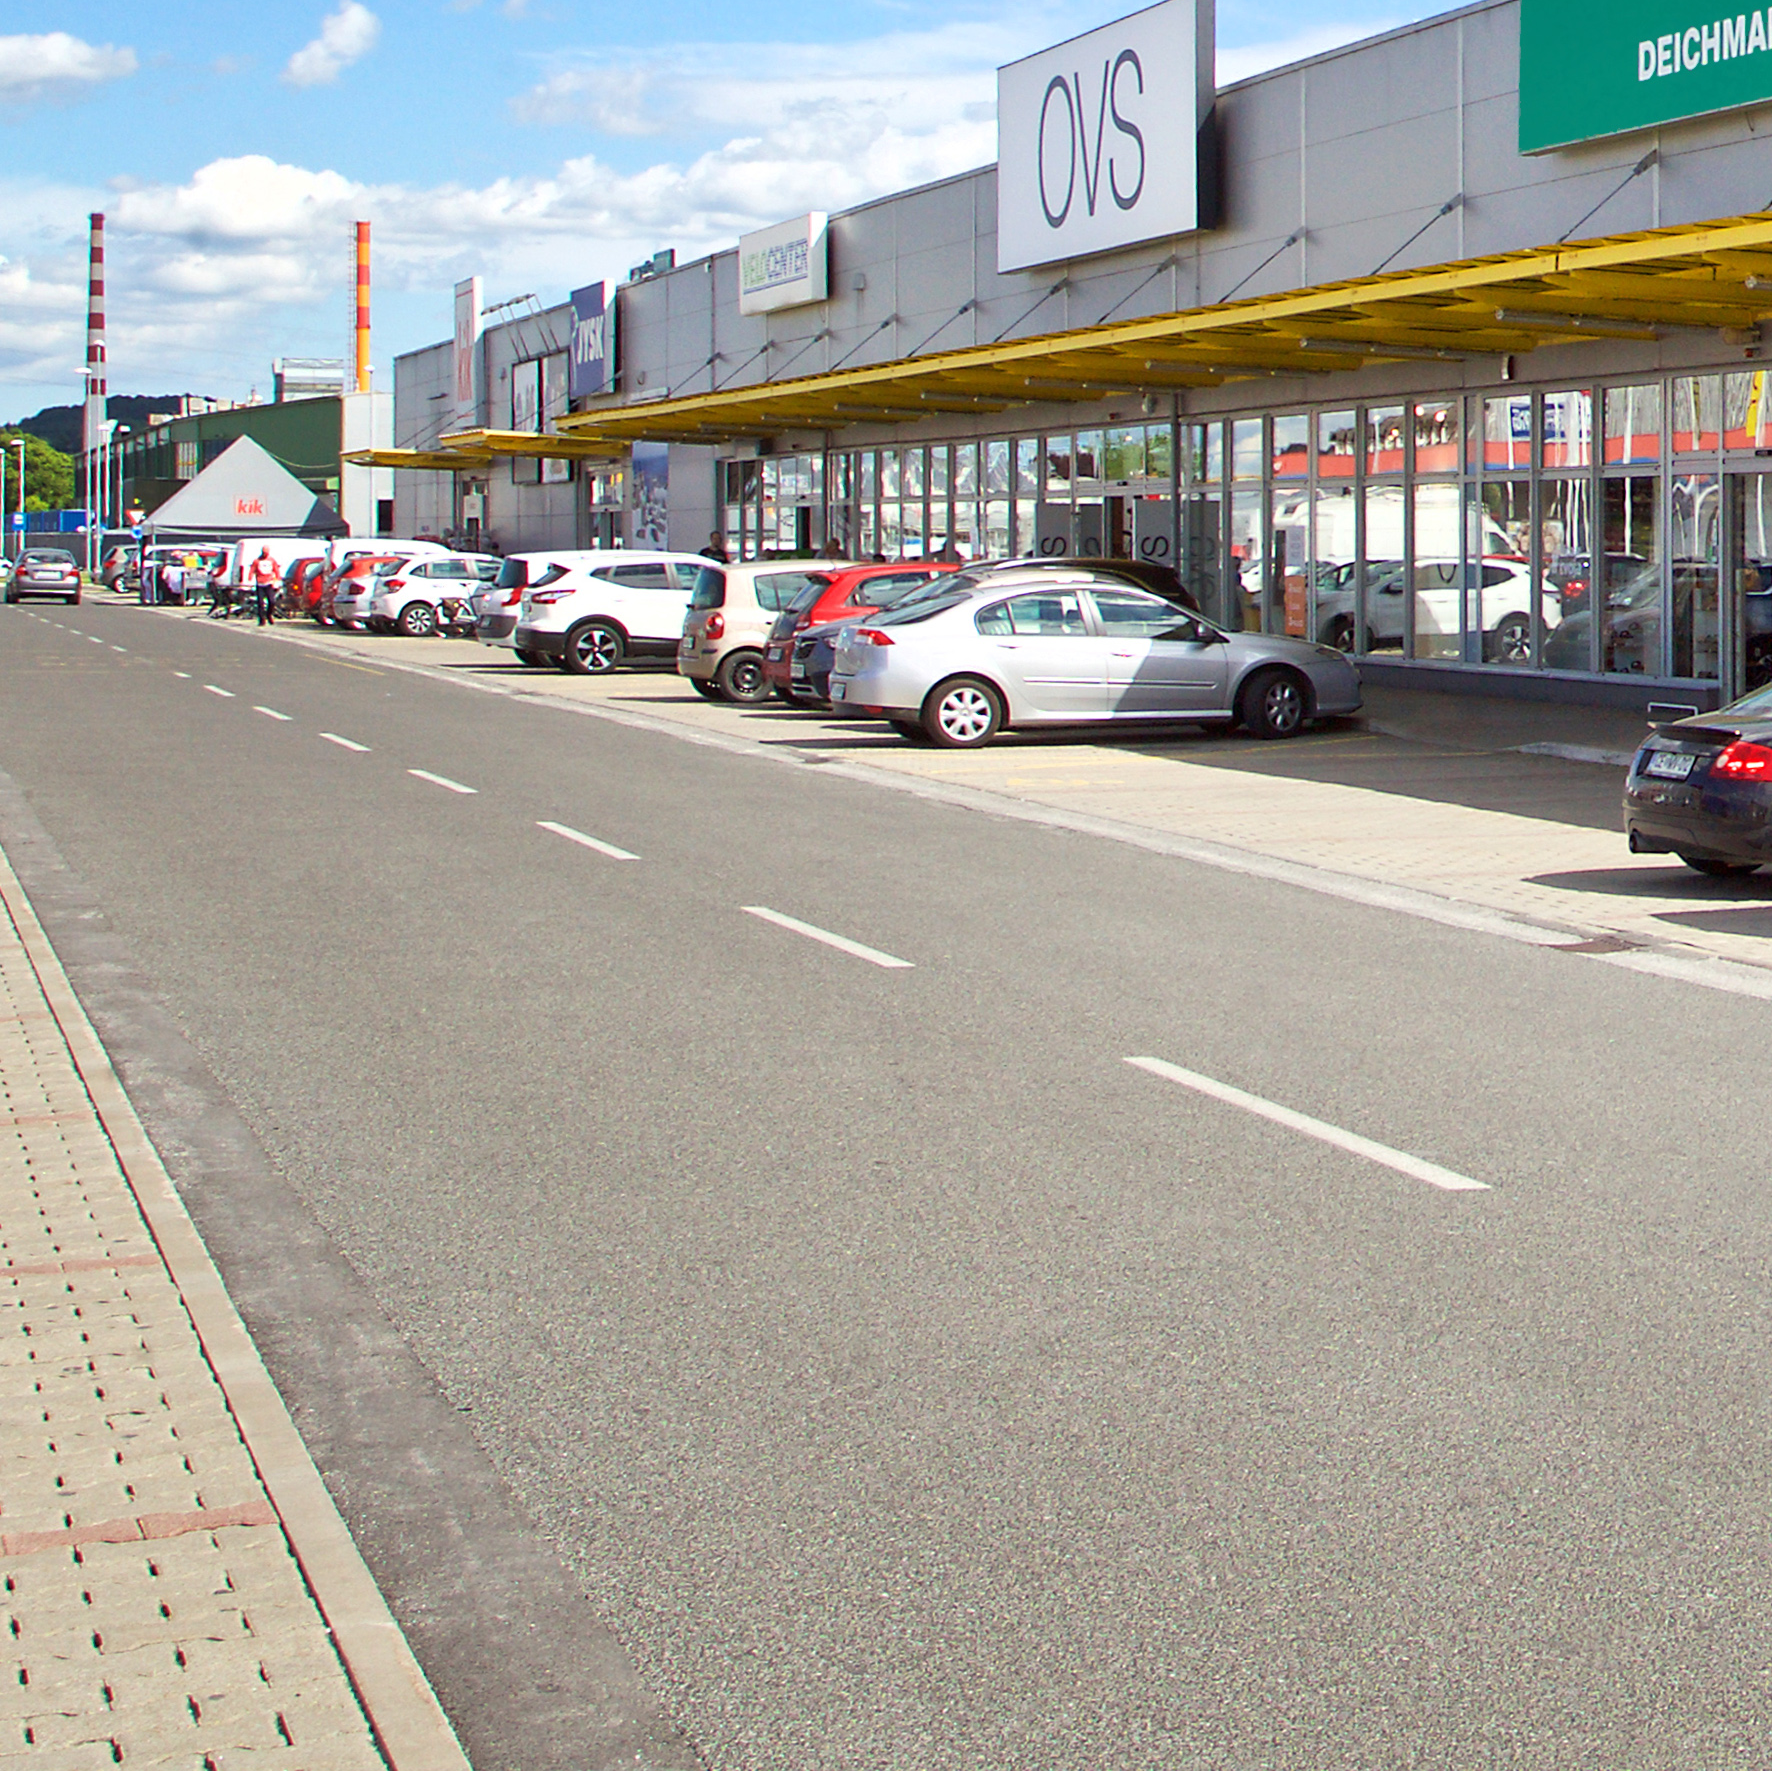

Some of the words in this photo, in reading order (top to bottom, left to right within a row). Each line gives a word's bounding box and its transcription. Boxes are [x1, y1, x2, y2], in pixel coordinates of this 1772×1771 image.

[1039, 49, 1145, 228] OVS
[576, 315, 604, 365] JYSK
[237, 499, 263, 514] kik
